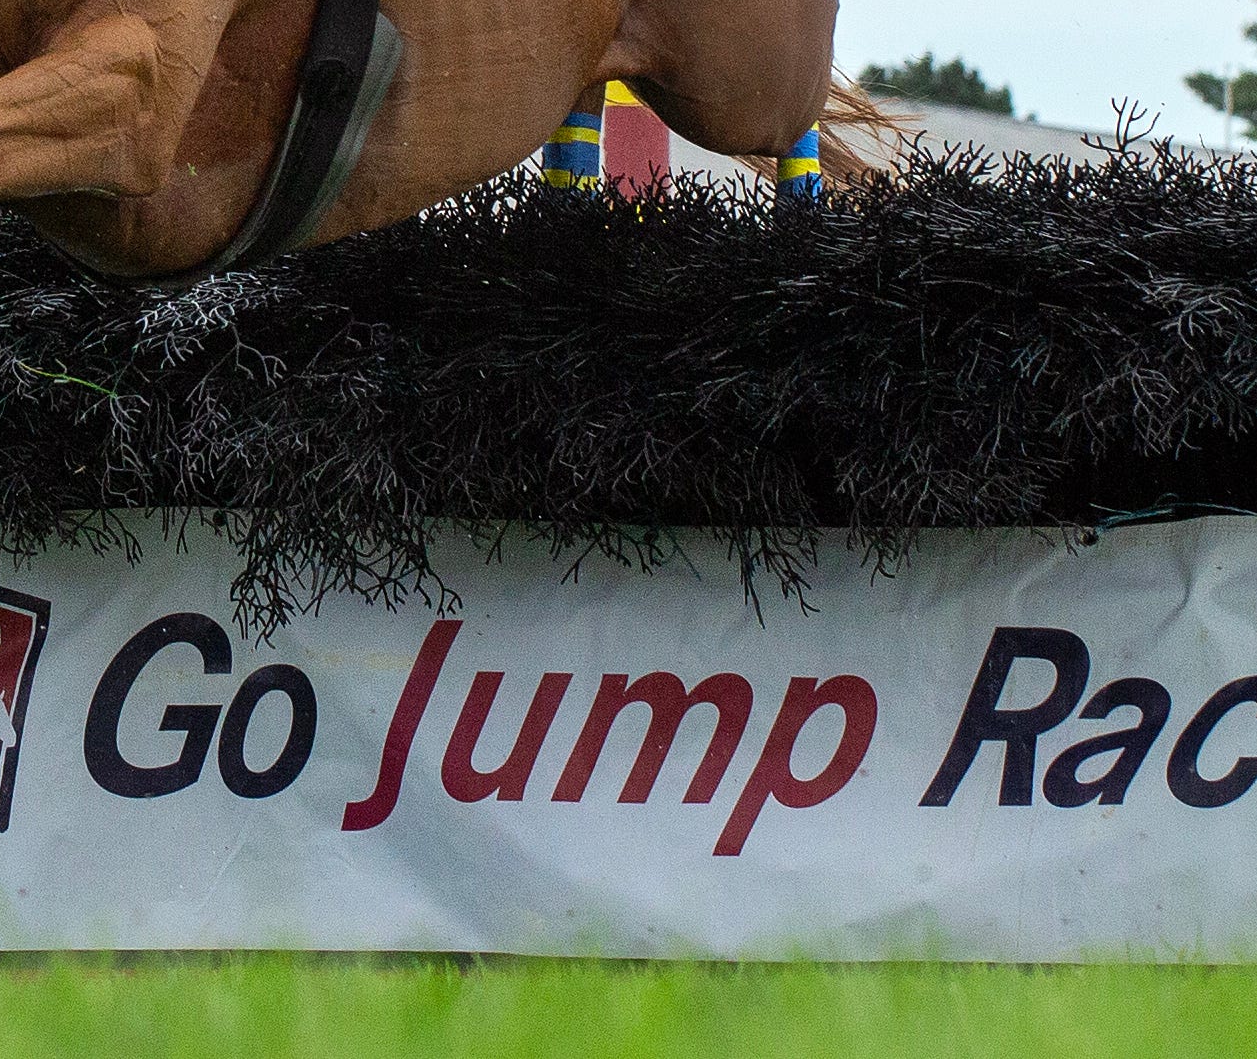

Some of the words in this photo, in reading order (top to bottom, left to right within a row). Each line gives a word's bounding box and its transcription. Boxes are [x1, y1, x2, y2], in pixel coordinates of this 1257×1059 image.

[83, 612, 318, 799] Go
[340, 619, 879, 857] Jump
[917, 626, 1257, 809] Rac
